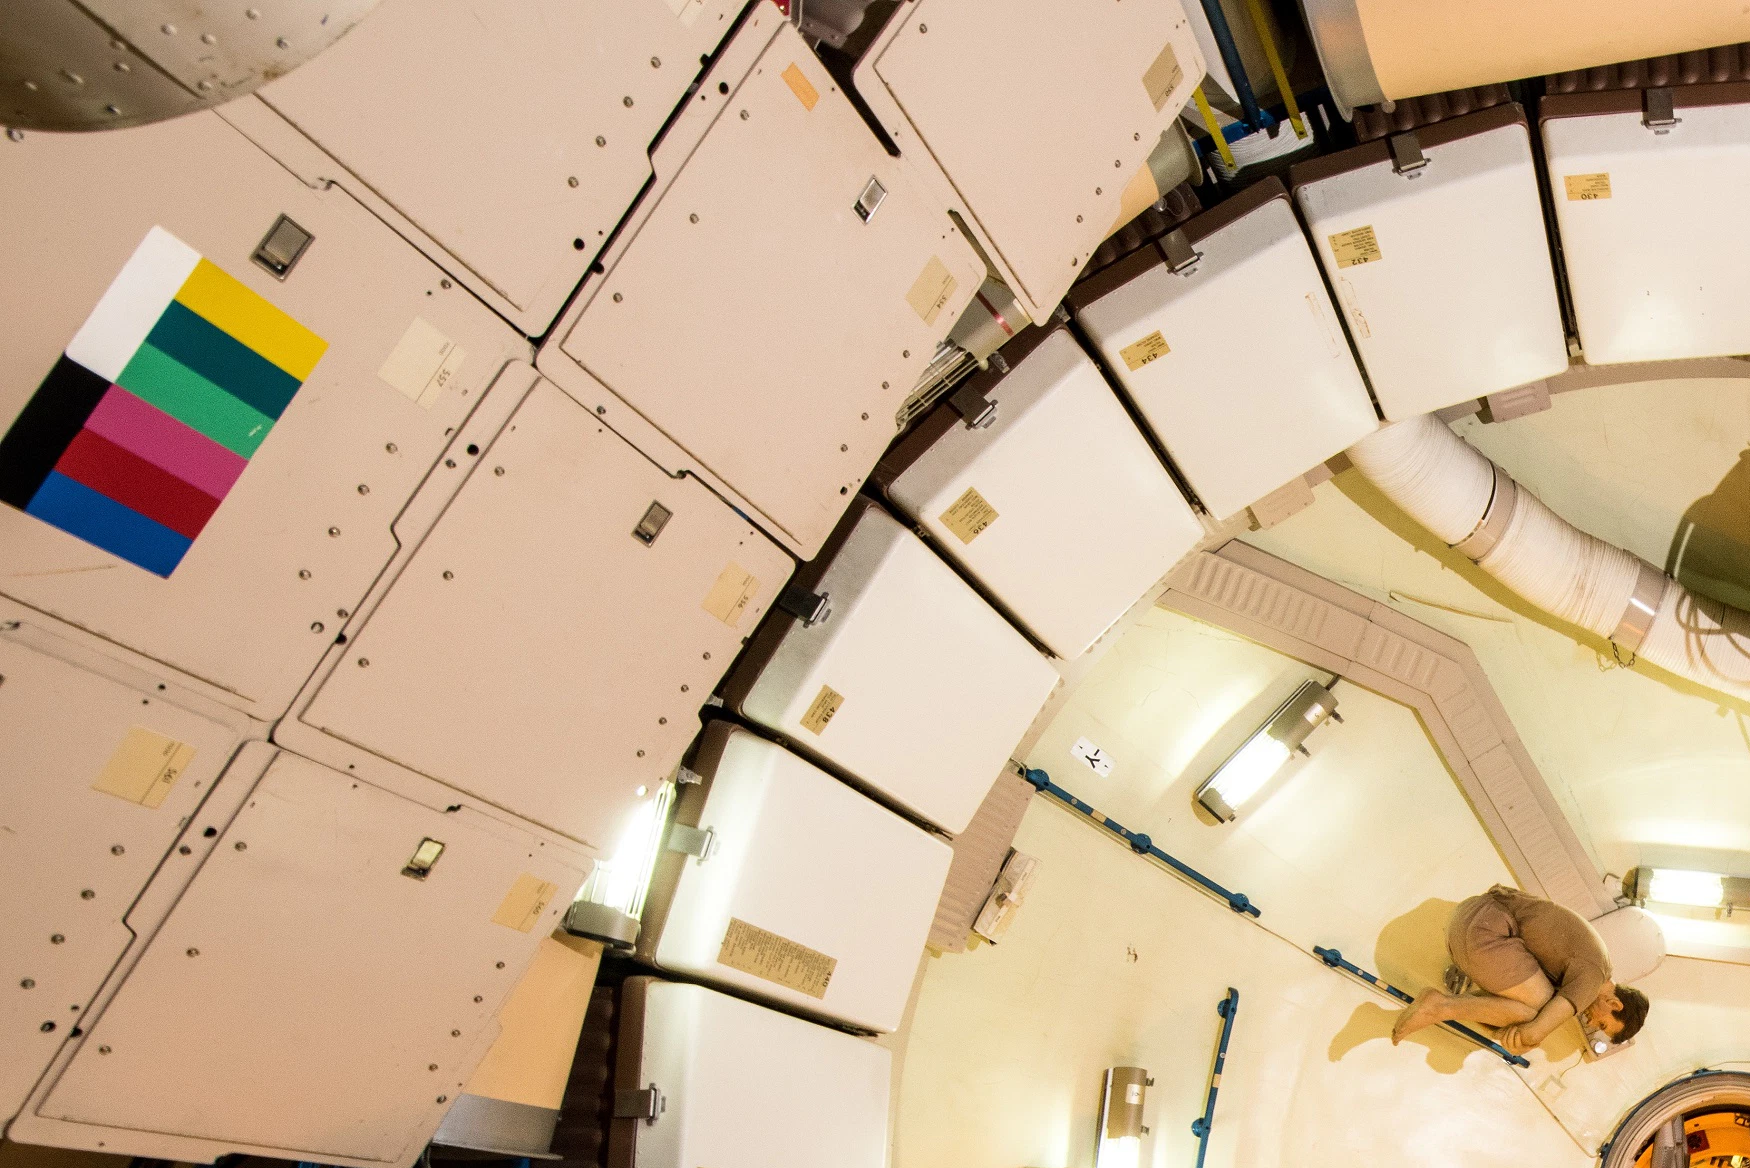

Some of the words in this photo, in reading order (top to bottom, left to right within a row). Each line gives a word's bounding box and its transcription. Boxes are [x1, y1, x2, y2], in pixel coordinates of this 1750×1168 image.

[1351, 257, 1368, 266] 432
[1141, 352, 1158, 366] 434
[436, 369, 451, 388] 557
[973, 521, 989, 536] 436
[822, 707, 836, 723] 438
[822, 971, 832, 988] 440
